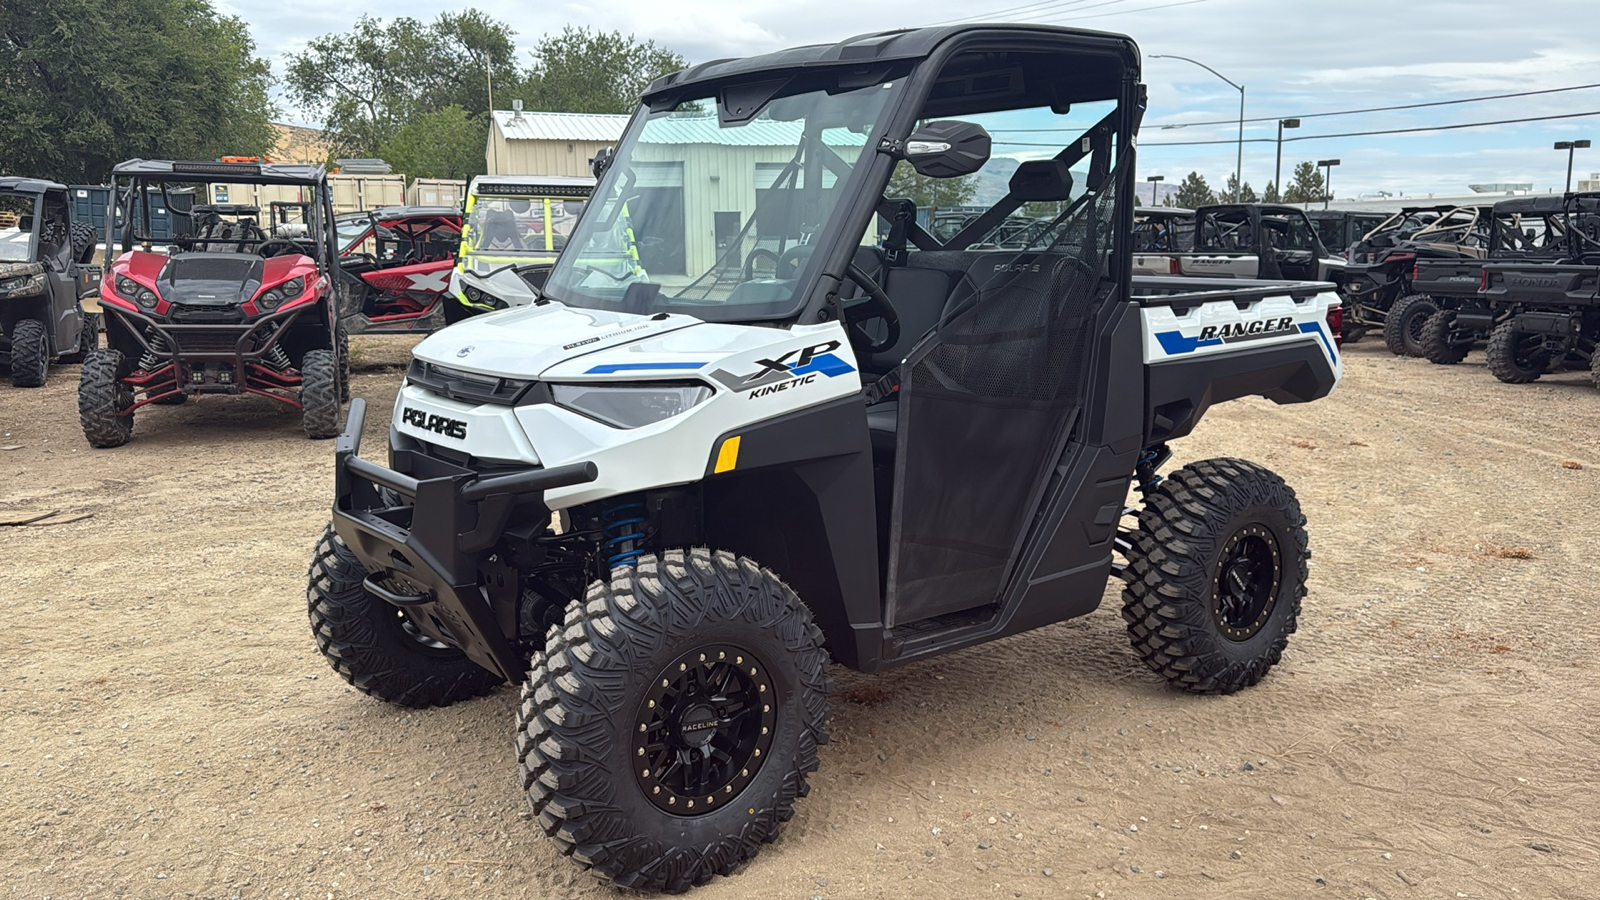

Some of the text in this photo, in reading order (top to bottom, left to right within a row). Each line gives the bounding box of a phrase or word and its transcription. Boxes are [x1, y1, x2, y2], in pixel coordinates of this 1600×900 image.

[1509, 277, 1562, 289] HONDA
[1199, 316, 1293, 341] RANGER
[748, 339, 842, 381] XP
[748, 373, 818, 400] KINETIC
[402, 406, 468, 441] POLARIS
[682, 720, 719, 732] RACELINE
